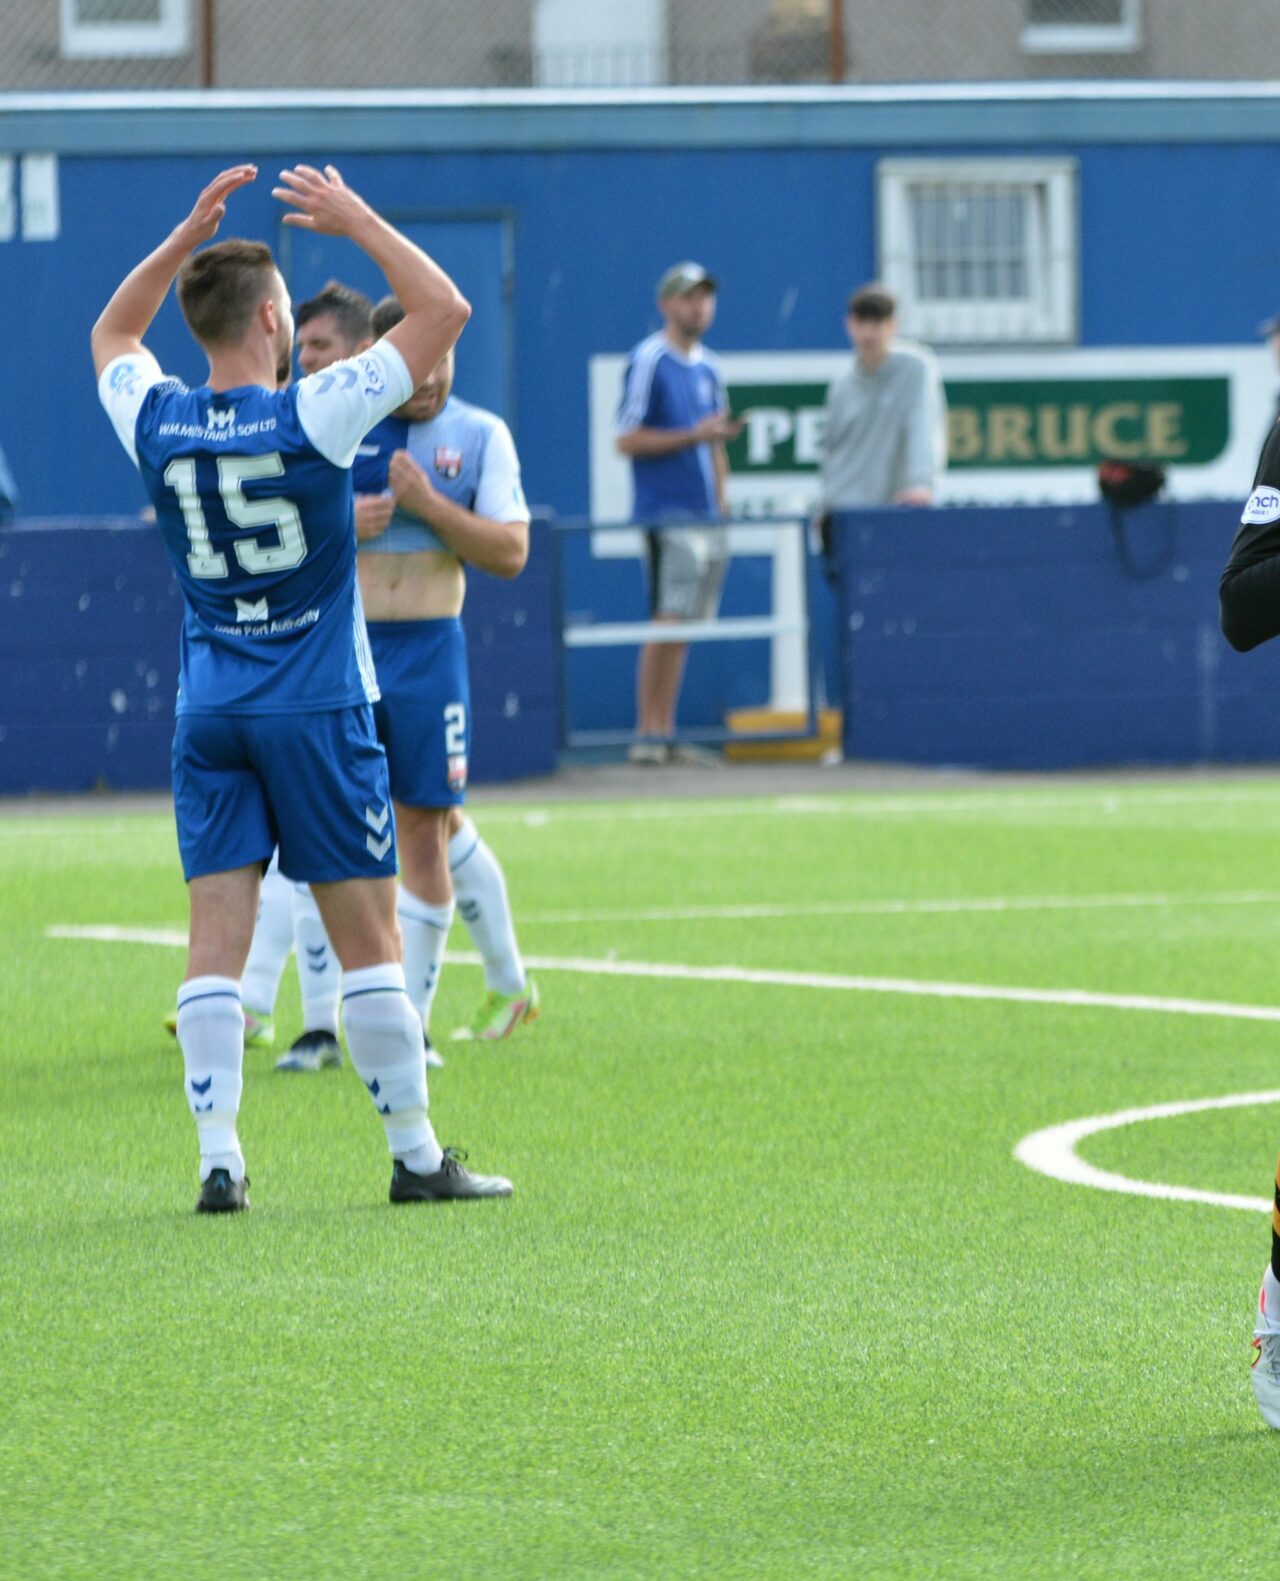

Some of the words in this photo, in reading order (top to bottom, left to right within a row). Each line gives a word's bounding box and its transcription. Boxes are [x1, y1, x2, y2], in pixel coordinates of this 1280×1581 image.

[236, 421, 258, 437] SON
[259, 416, 277, 433] LTD
[744, 406, 825, 463] PE
[944, 401, 1190, 462] BRUCE
[164, 451, 308, 579] 15
[244, 623, 270, 637] Port
[270, 608, 320, 635] Authority
[443, 702, 466, 755] 2
